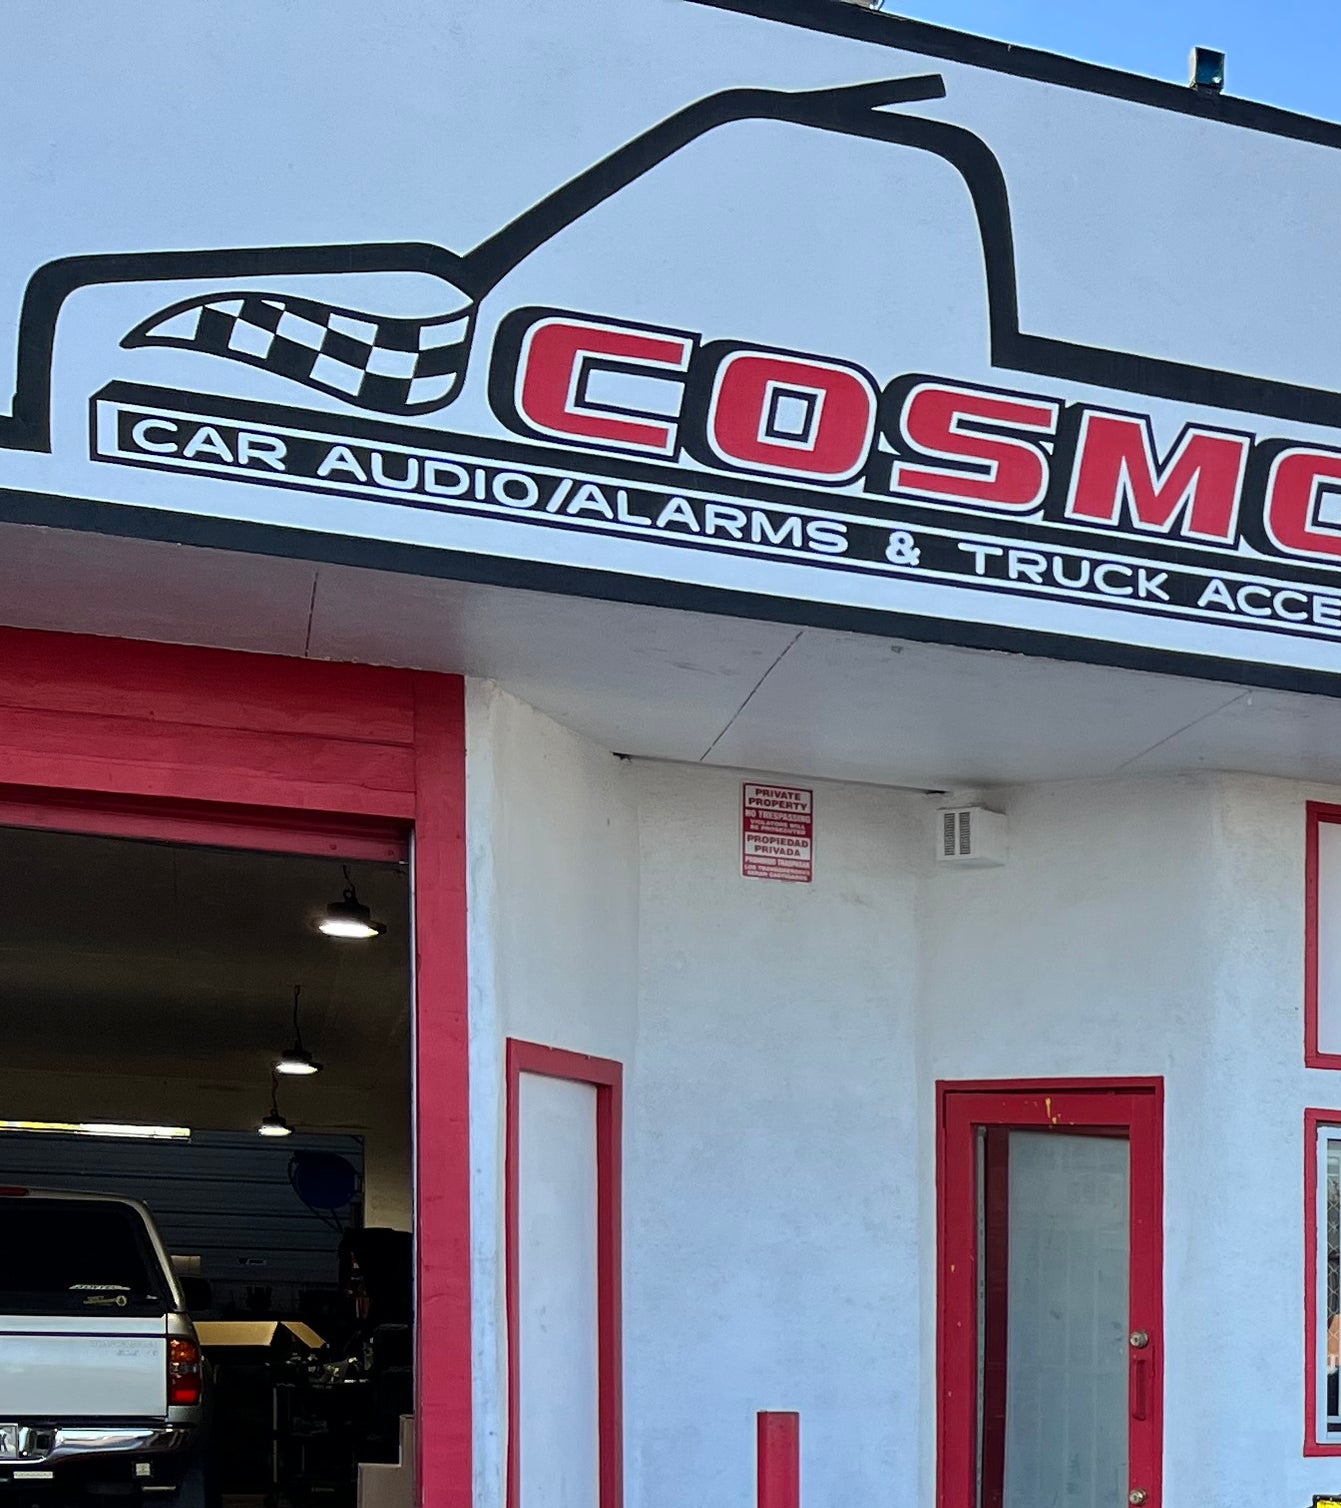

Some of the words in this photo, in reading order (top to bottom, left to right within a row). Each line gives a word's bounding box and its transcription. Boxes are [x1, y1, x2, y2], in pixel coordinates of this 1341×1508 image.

[131, 418, 288, 471] CAR
[317, 444, 850, 555] AUDIO/ALARMS
[884, 530, 921, 567] &
[957, 541, 1171, 601] TRUCK
[755, 788, 802, 801] PRIVATE
[748, 797, 808, 811] PROPERTY
[747, 834, 809, 848] PROPIEDAD
[754, 845, 801, 856] PRIVADA
